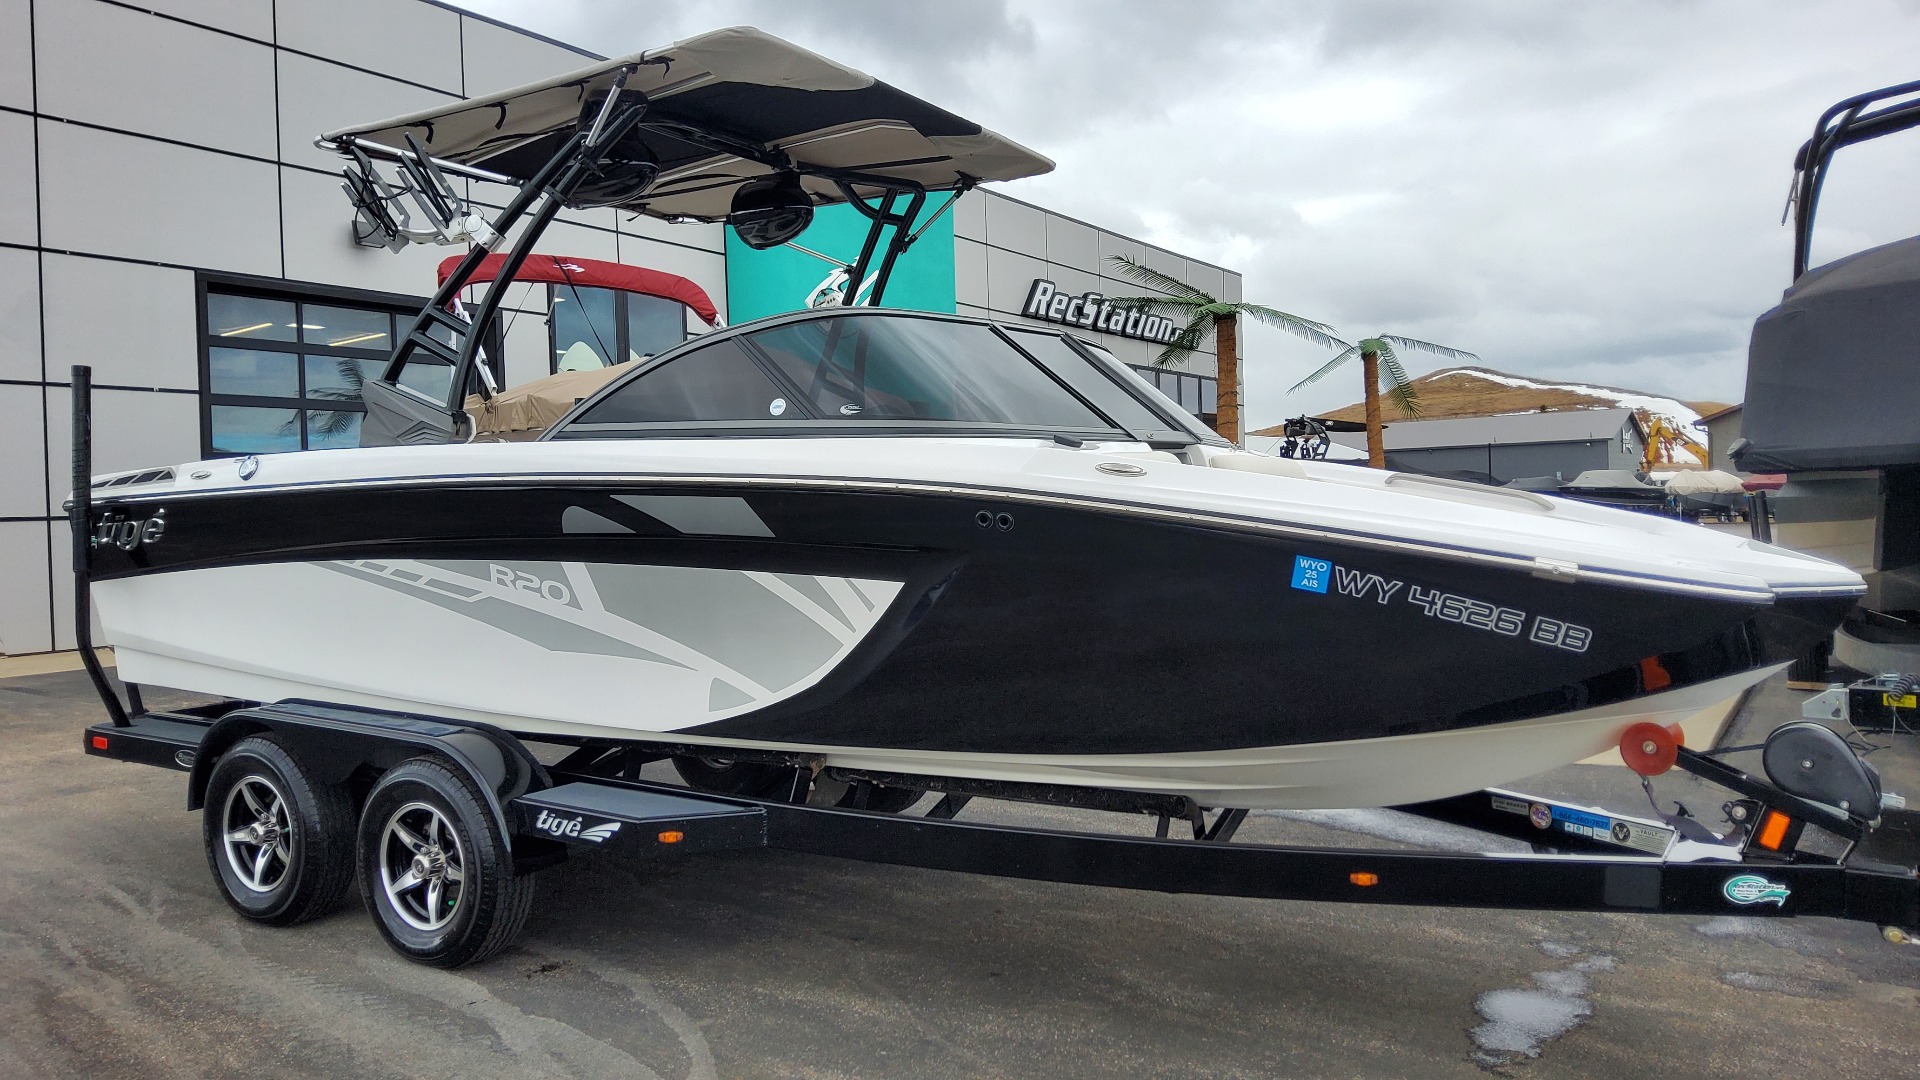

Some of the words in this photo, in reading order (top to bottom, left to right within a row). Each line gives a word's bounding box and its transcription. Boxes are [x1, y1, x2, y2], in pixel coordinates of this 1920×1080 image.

[1300, 559, 1328, 572] WYO
[1305, 569, 1318, 579] 25
[490, 563, 571, 606] R20
[1301, 578, 1319, 588] AIS
[1334, 565, 1404, 605] WY
[1408, 585, 1526, 636] 4626
[1530, 616, 1593, 652] BB
